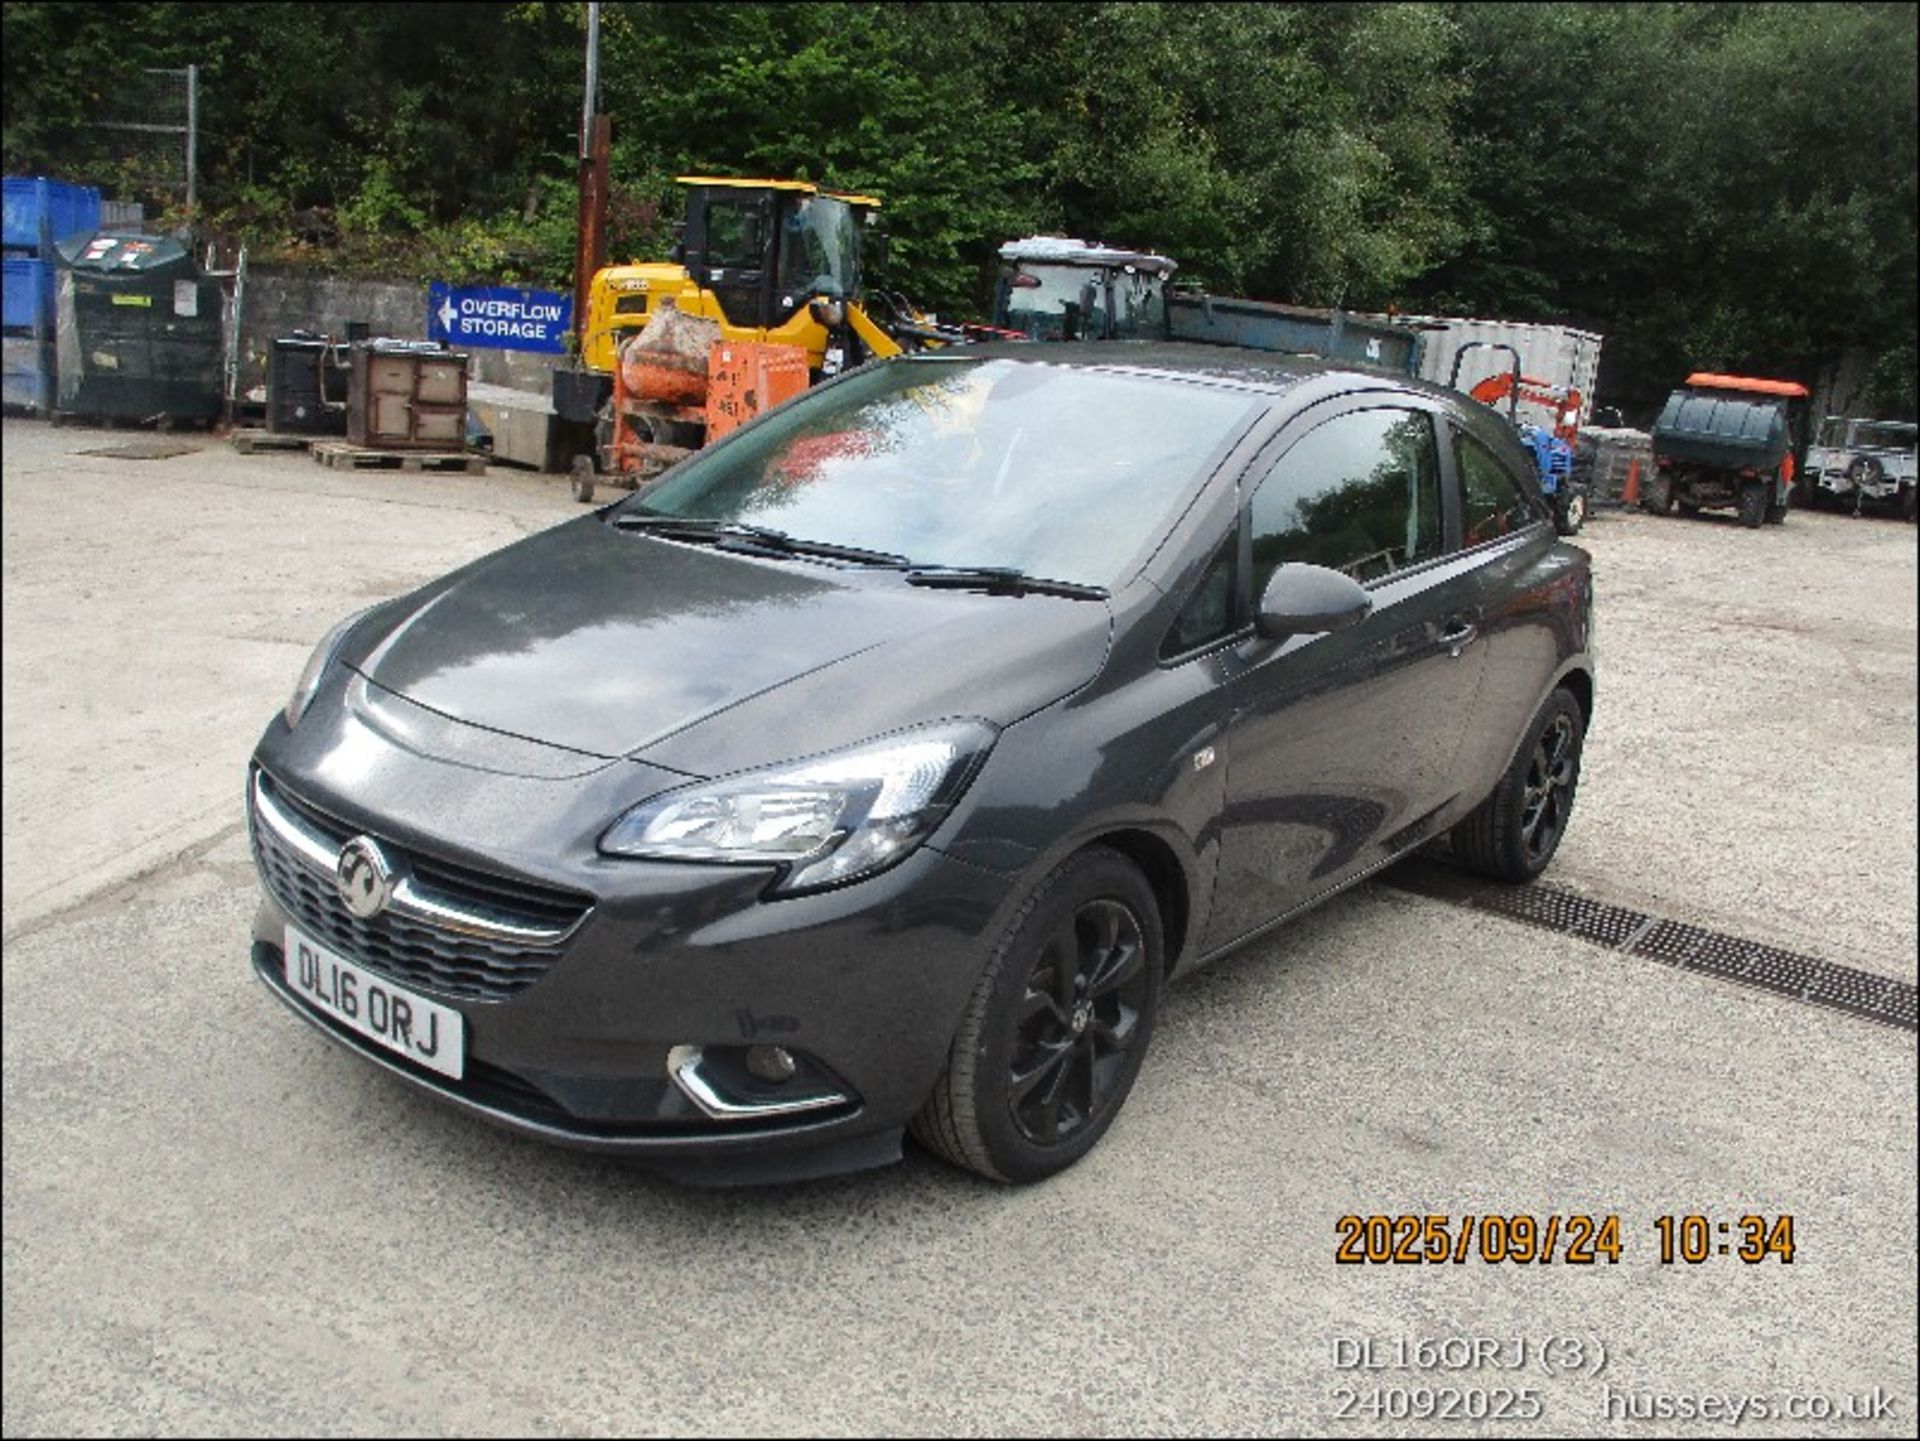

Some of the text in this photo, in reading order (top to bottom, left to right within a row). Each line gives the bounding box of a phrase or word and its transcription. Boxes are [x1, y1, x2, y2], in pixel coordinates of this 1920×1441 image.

[461, 298, 561, 321] OVERFLOW
[461, 317, 547, 339] STORAGE
[299, 942, 438, 1058] DL16 ORJ
